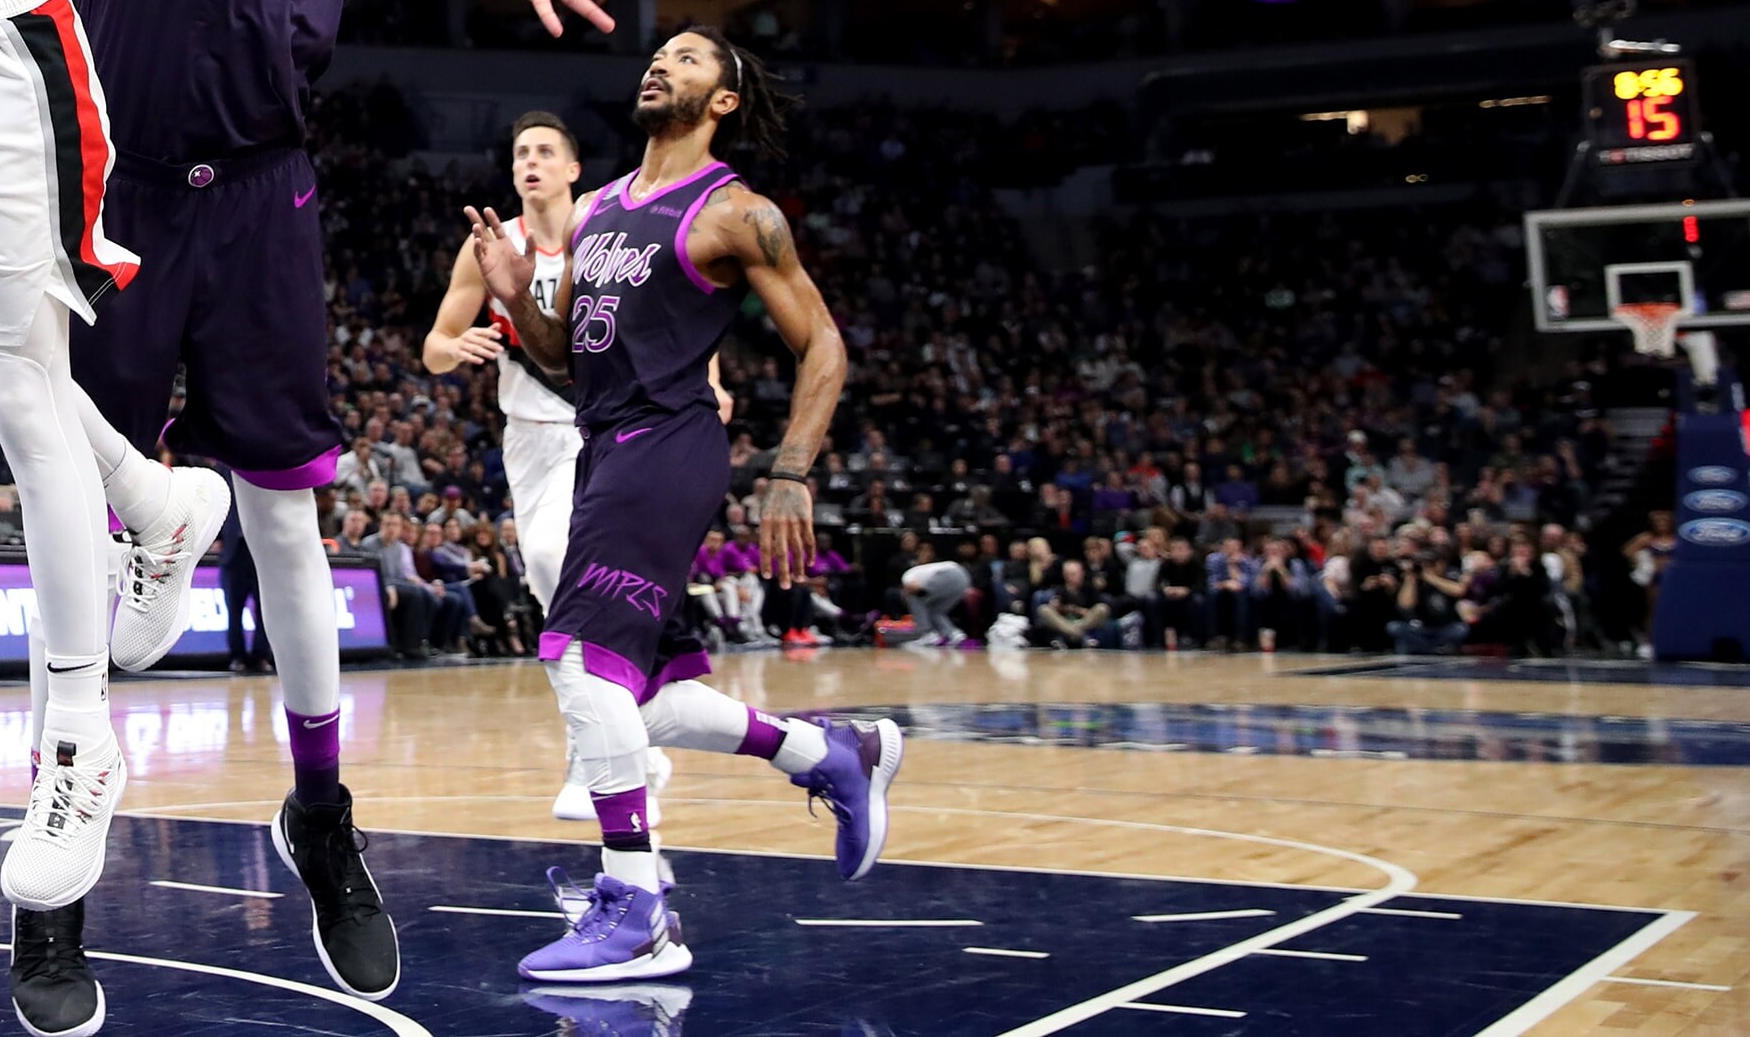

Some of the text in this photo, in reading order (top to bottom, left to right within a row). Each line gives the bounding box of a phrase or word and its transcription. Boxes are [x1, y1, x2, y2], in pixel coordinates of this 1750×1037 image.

[1627, 96, 1681, 141] 15
[572, 232, 662, 289] Wolves
[572, 294, 622, 354] 25
[577, 563, 668, 622] MPLS
